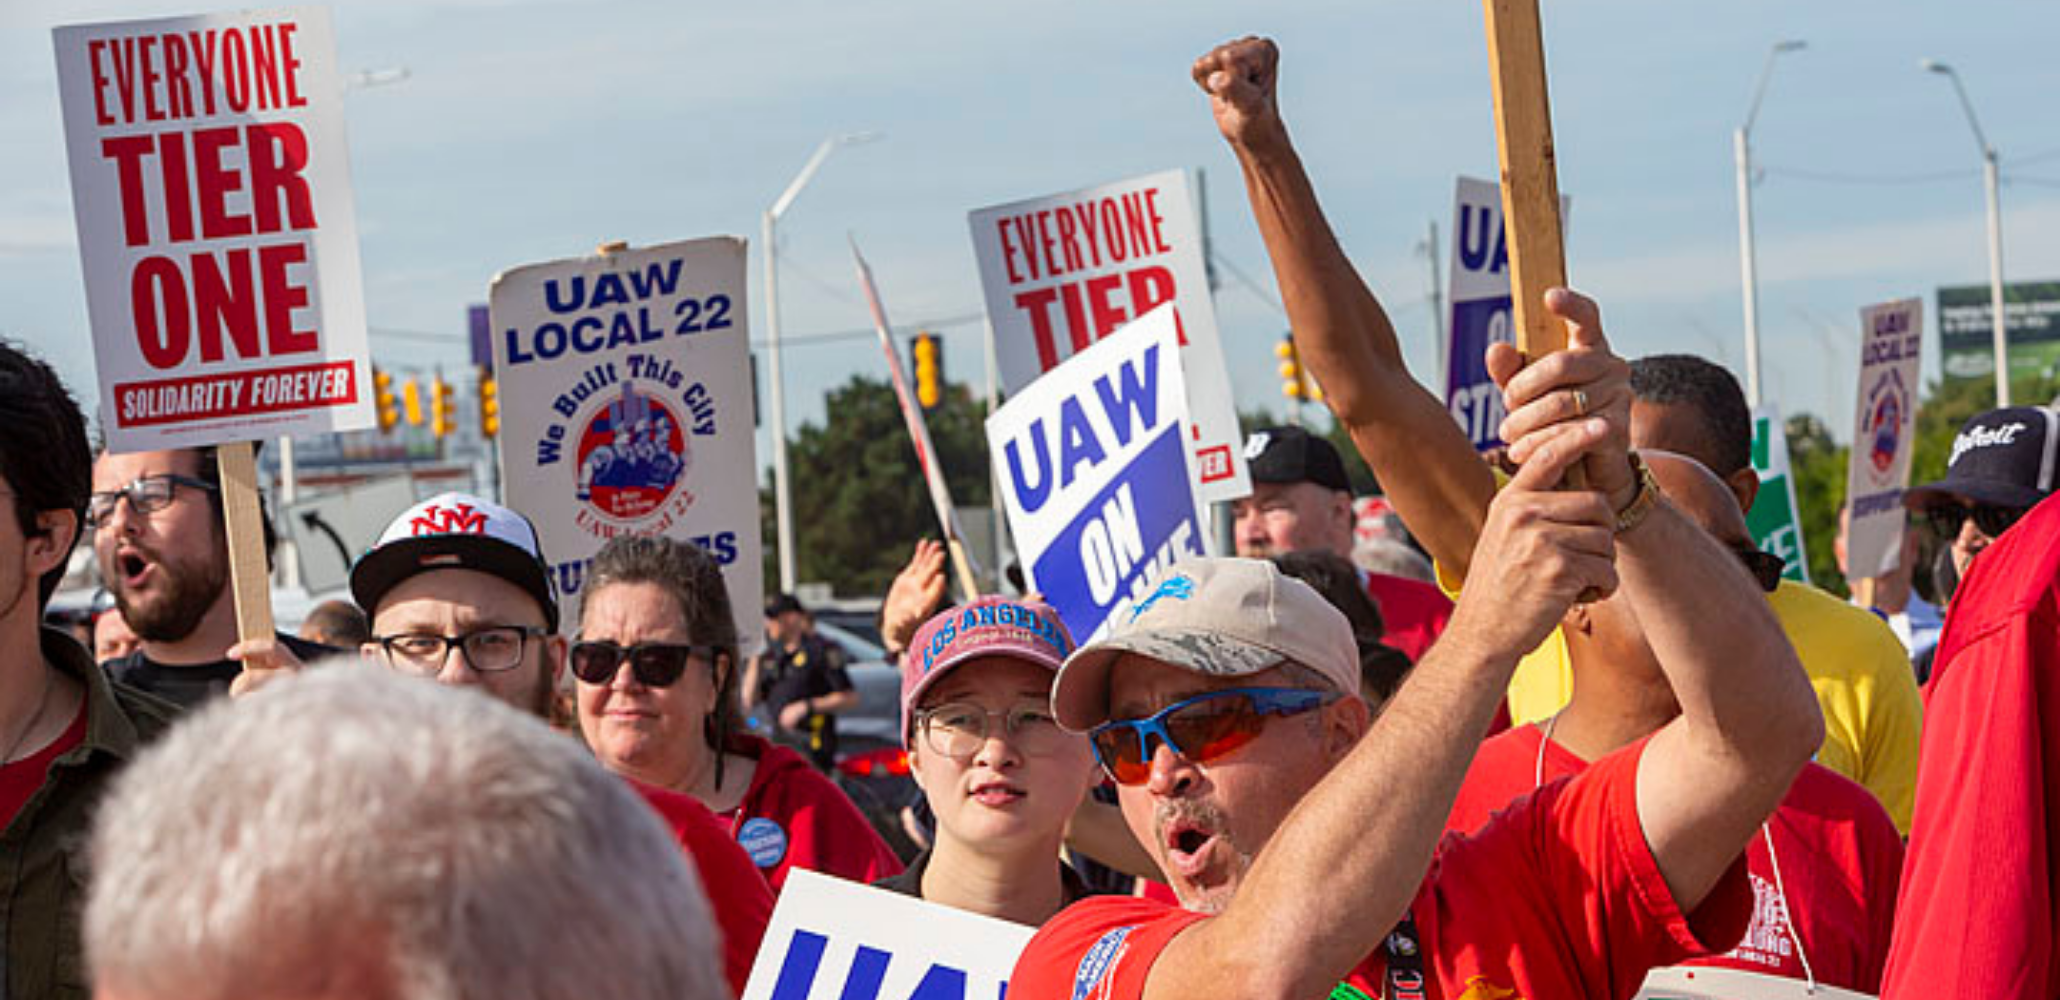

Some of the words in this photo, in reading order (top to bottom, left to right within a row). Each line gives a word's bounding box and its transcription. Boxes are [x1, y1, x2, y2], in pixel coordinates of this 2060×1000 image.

[88, 22, 307, 126] EVERYONE
[102, 121, 318, 247] TIER
[997, 188, 1172, 284] EVERYONE
[131, 243, 318, 369] ONE
[506, 307, 664, 364] LOCAL
[675, 294, 733, 336] 22
[544, 259, 684, 314] UAW
[124, 378, 244, 419] SOLIDARITY
[251, 368, 349, 406] FOREVER
[537, 424, 565, 466] We
[553, 362, 618, 418] Built
[626, 354, 684, 388] This
[683, 382, 716, 435] City
[1004, 343, 1160, 513] UAW
[1081, 481, 1144, 607] ON
[923, 618, 956, 673] LOS
